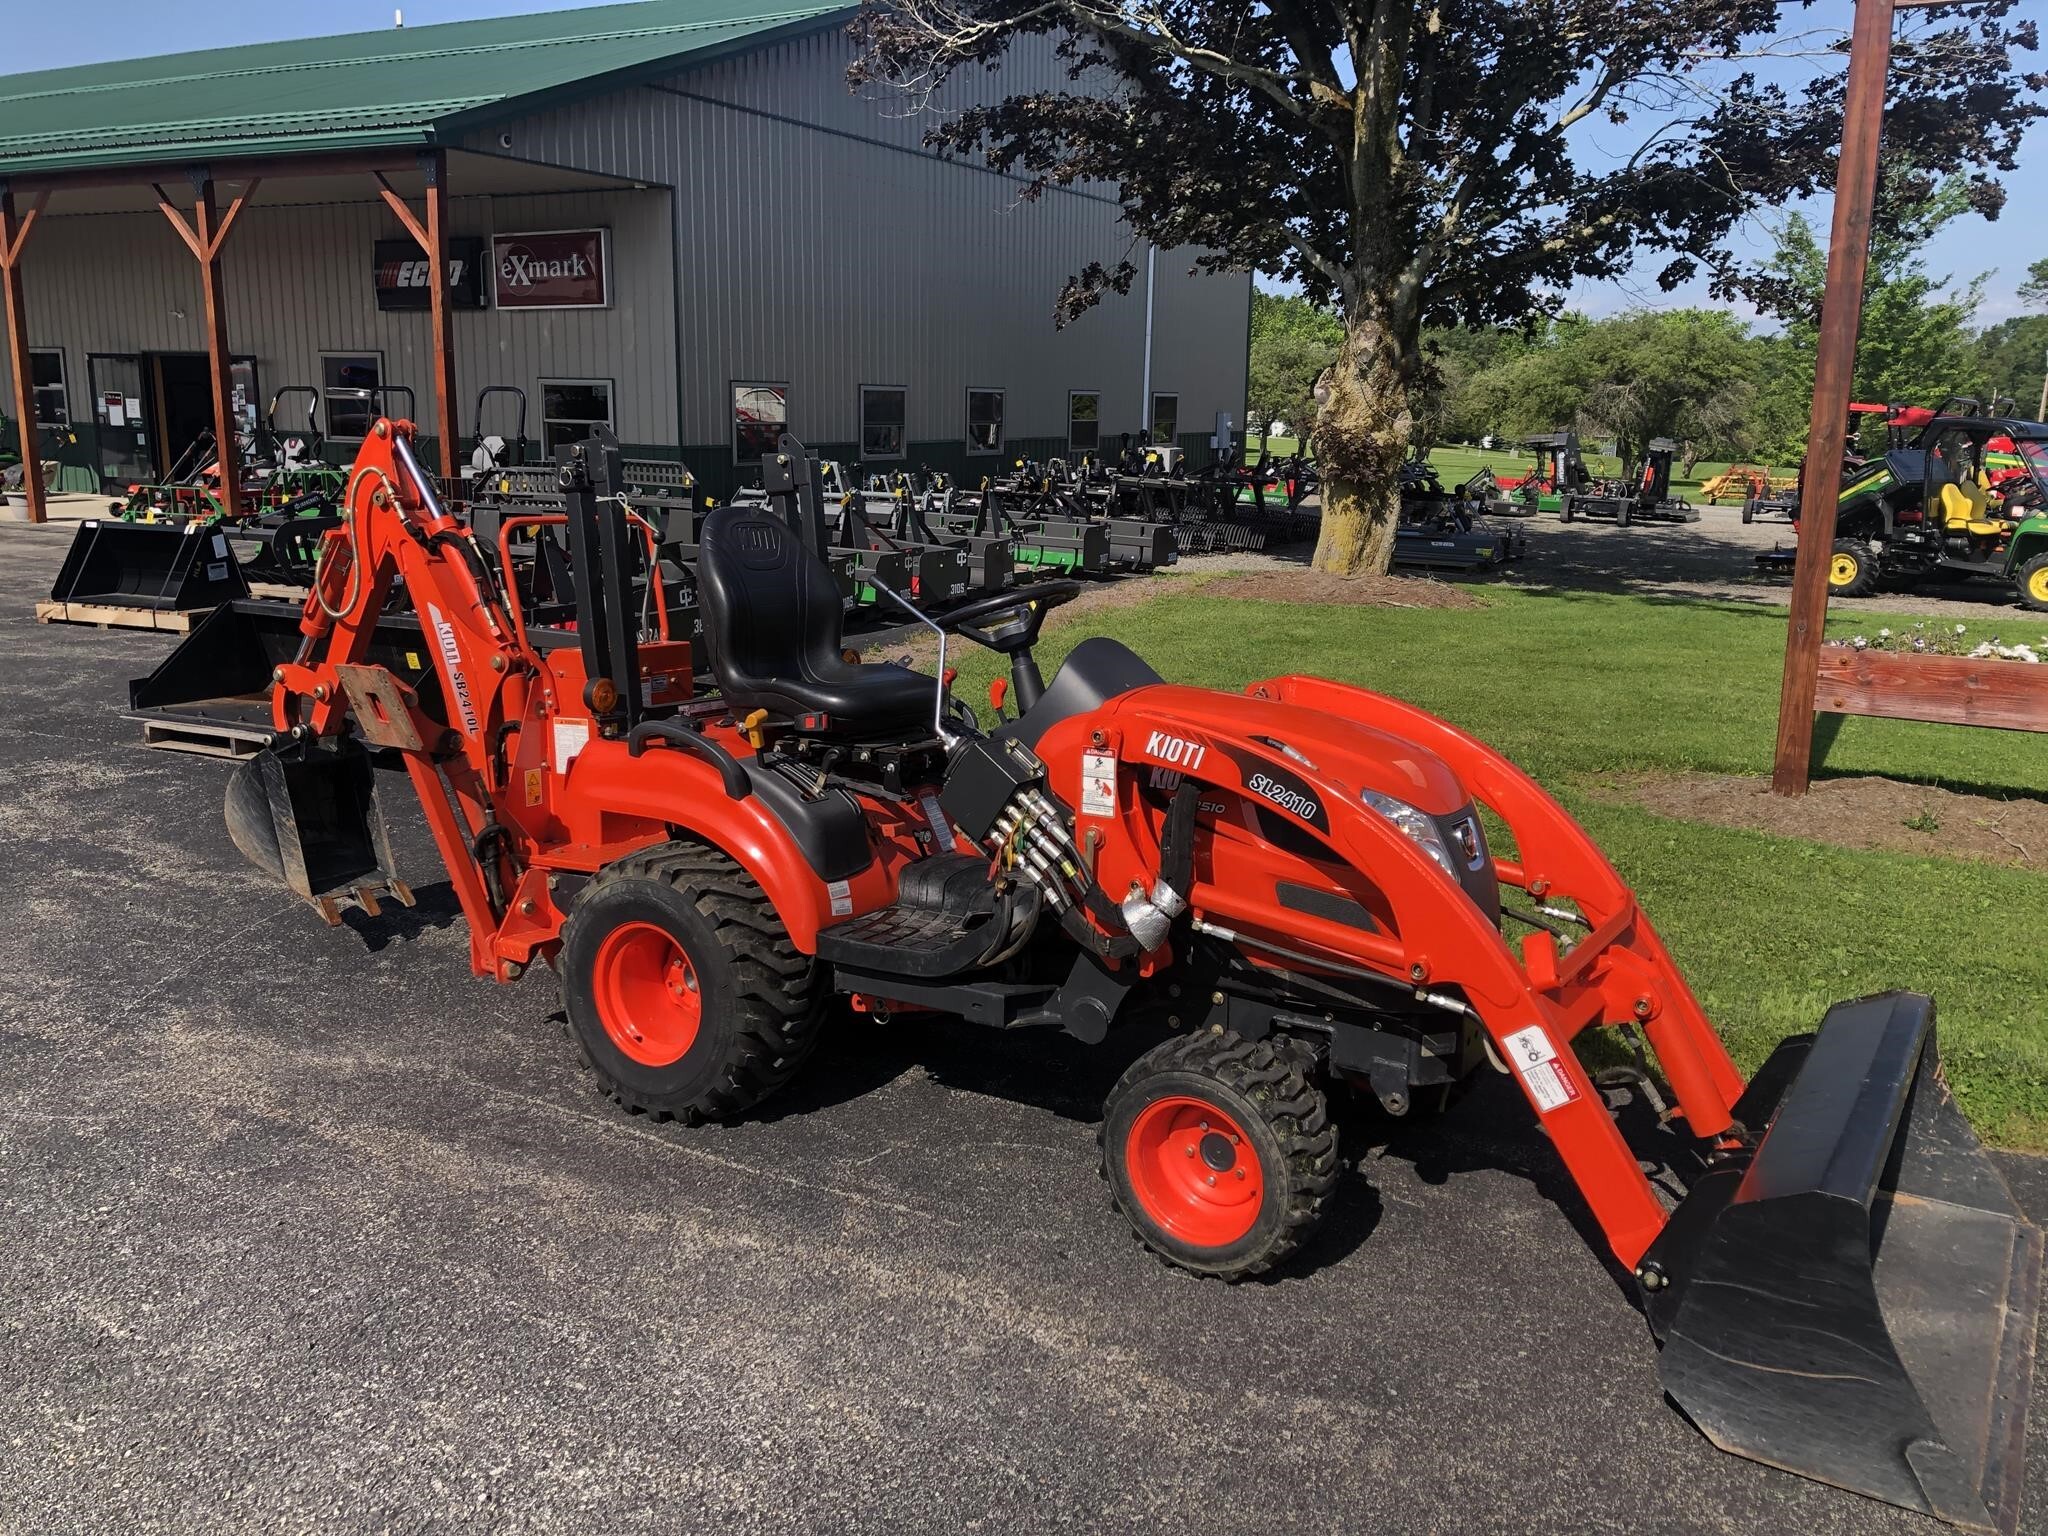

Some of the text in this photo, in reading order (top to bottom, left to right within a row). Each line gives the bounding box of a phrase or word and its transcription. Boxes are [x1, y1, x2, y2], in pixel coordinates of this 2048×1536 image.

[397, 261, 463, 287] ECO
[501, 253, 587, 286] eXmark
[951, 583, 965, 595] 310S
[438, 622, 461, 665] KIOTI
[454, 672, 480, 734] SB2410L
[1145, 730, 1206, 771] KIOTI
[1149, 766, 1185, 791] KIO
[1250, 773, 1317, 820] SL2410
[1557, 1068, 1576, 1097] DANGER
